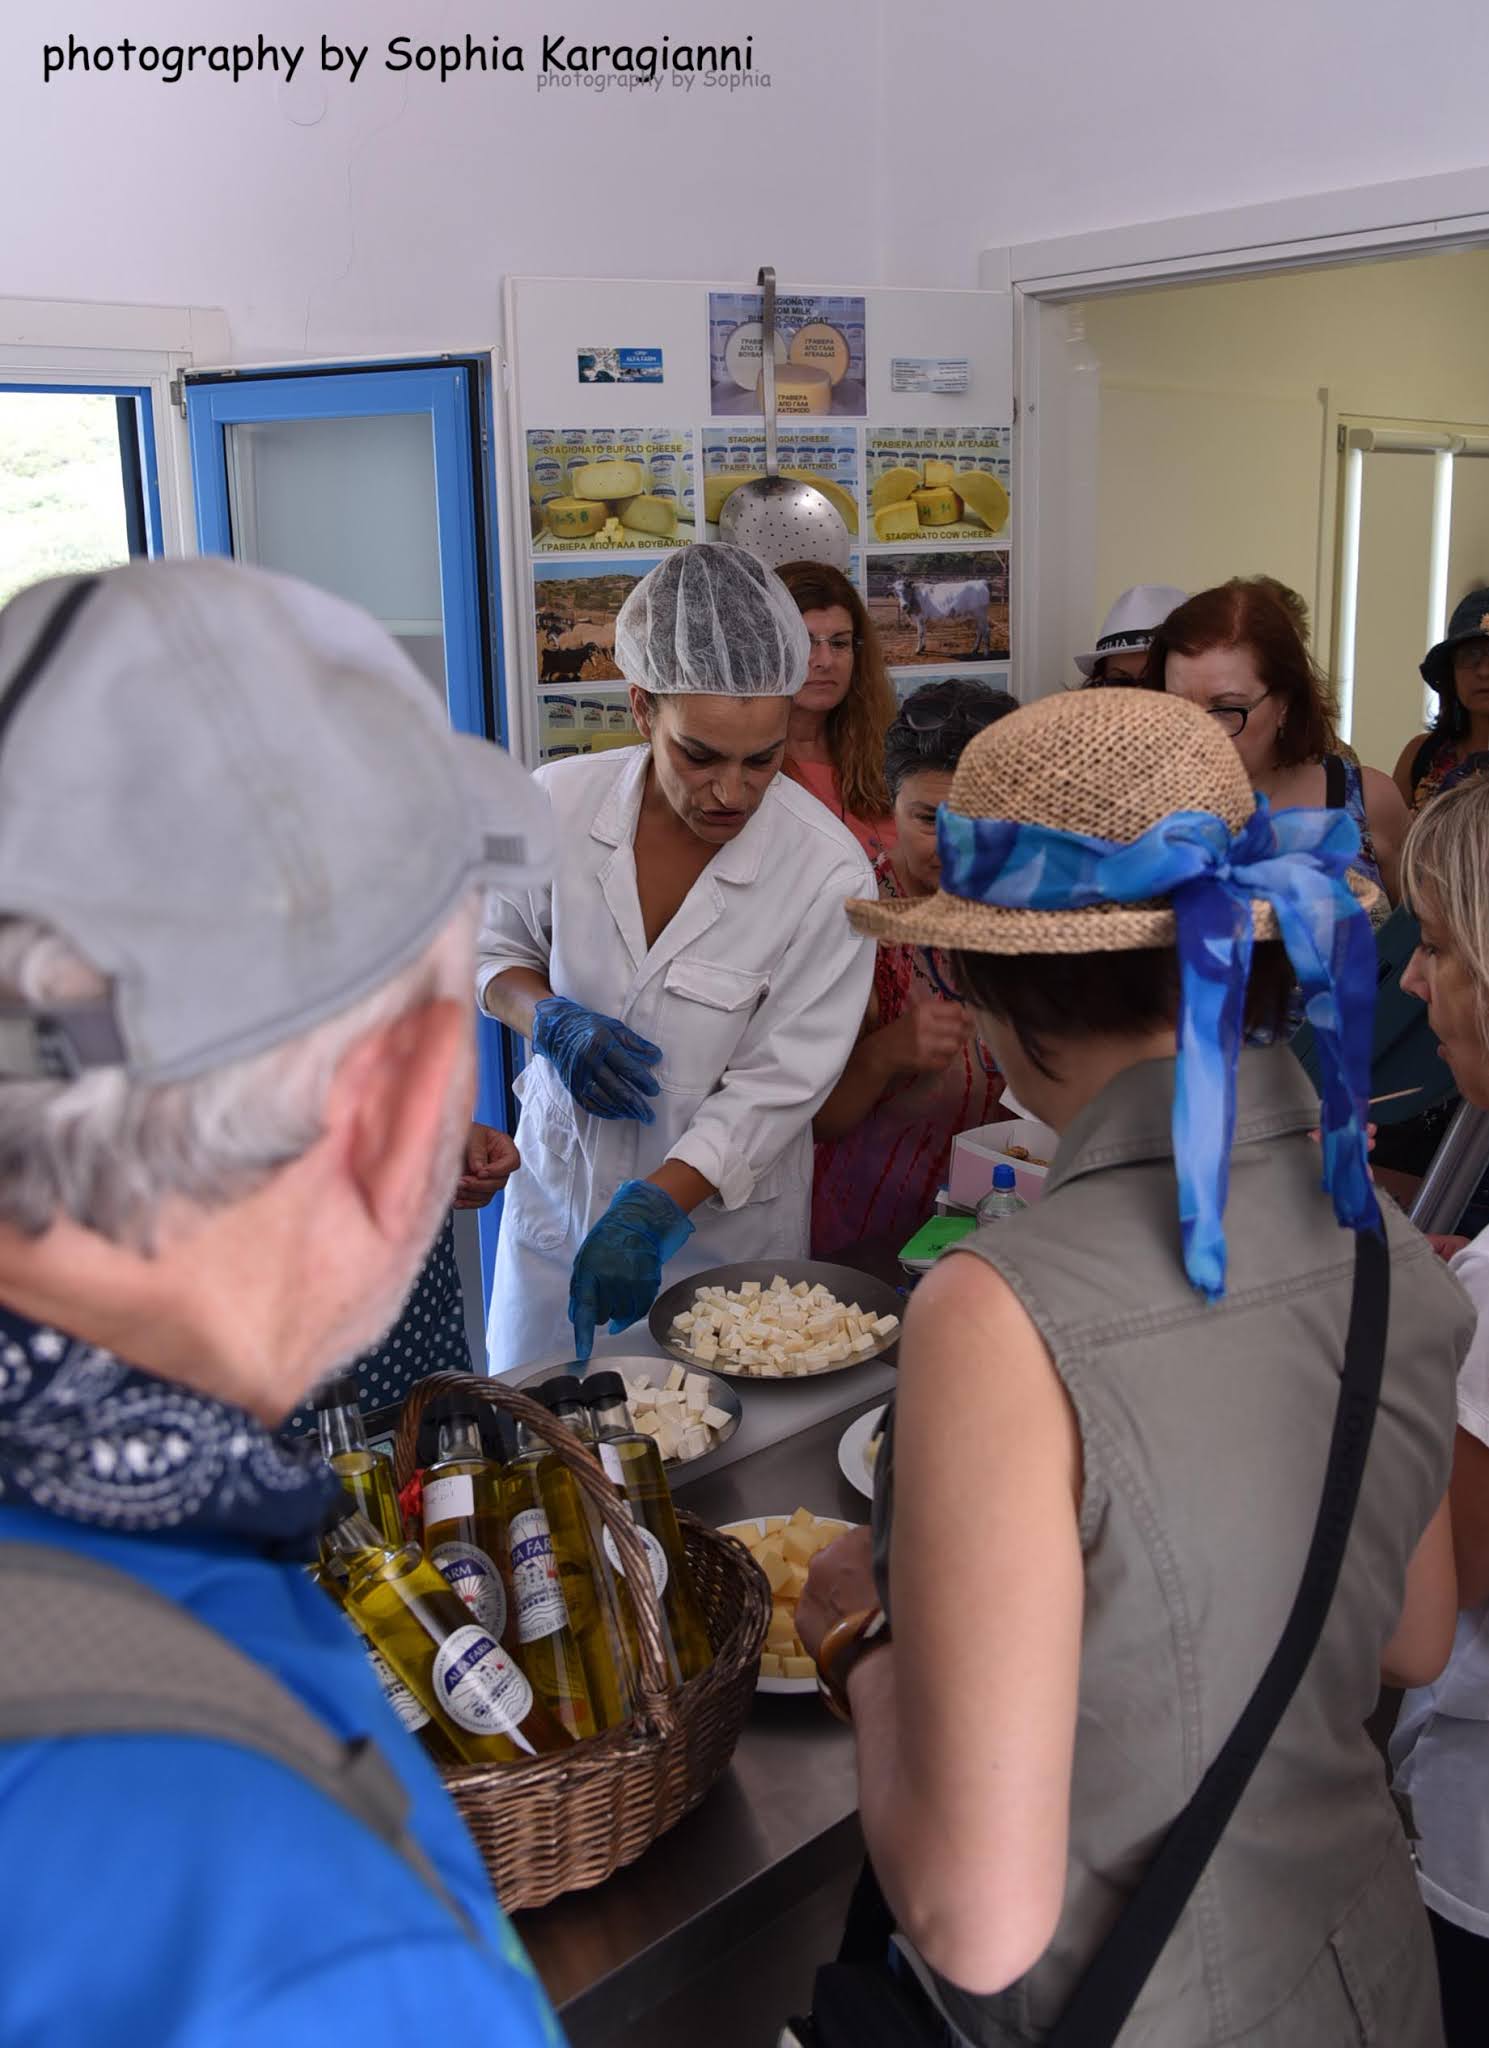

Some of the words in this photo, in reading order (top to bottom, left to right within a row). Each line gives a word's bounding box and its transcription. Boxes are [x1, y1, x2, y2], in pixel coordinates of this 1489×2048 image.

[728, 436, 766, 444] STAGIONA
[872, 441, 913, 449] ΓΡΑΒΙΕΡΑ
[914, 441, 933, 449] ΑΠΟ
[934, 441, 956, 449] ΓΑΛΑ
[957, 440, 1000, 448] ΑΓΕΛΑΔΑΣ
[543, 445, 605, 455] STAGIONATO
[606, 445, 645, 454] BUFALO
[646, 444, 683, 453] CHEESE
[886, 532, 938, 541] STAGIONATO
[939, 531, 960, 539] COW
[961, 530, 993, 538] CHEESE
[541, 543, 588, 552] ΓΡΑΒΙΕΡΑ
[611, 541, 636, 550] ΓΑΛΑ
